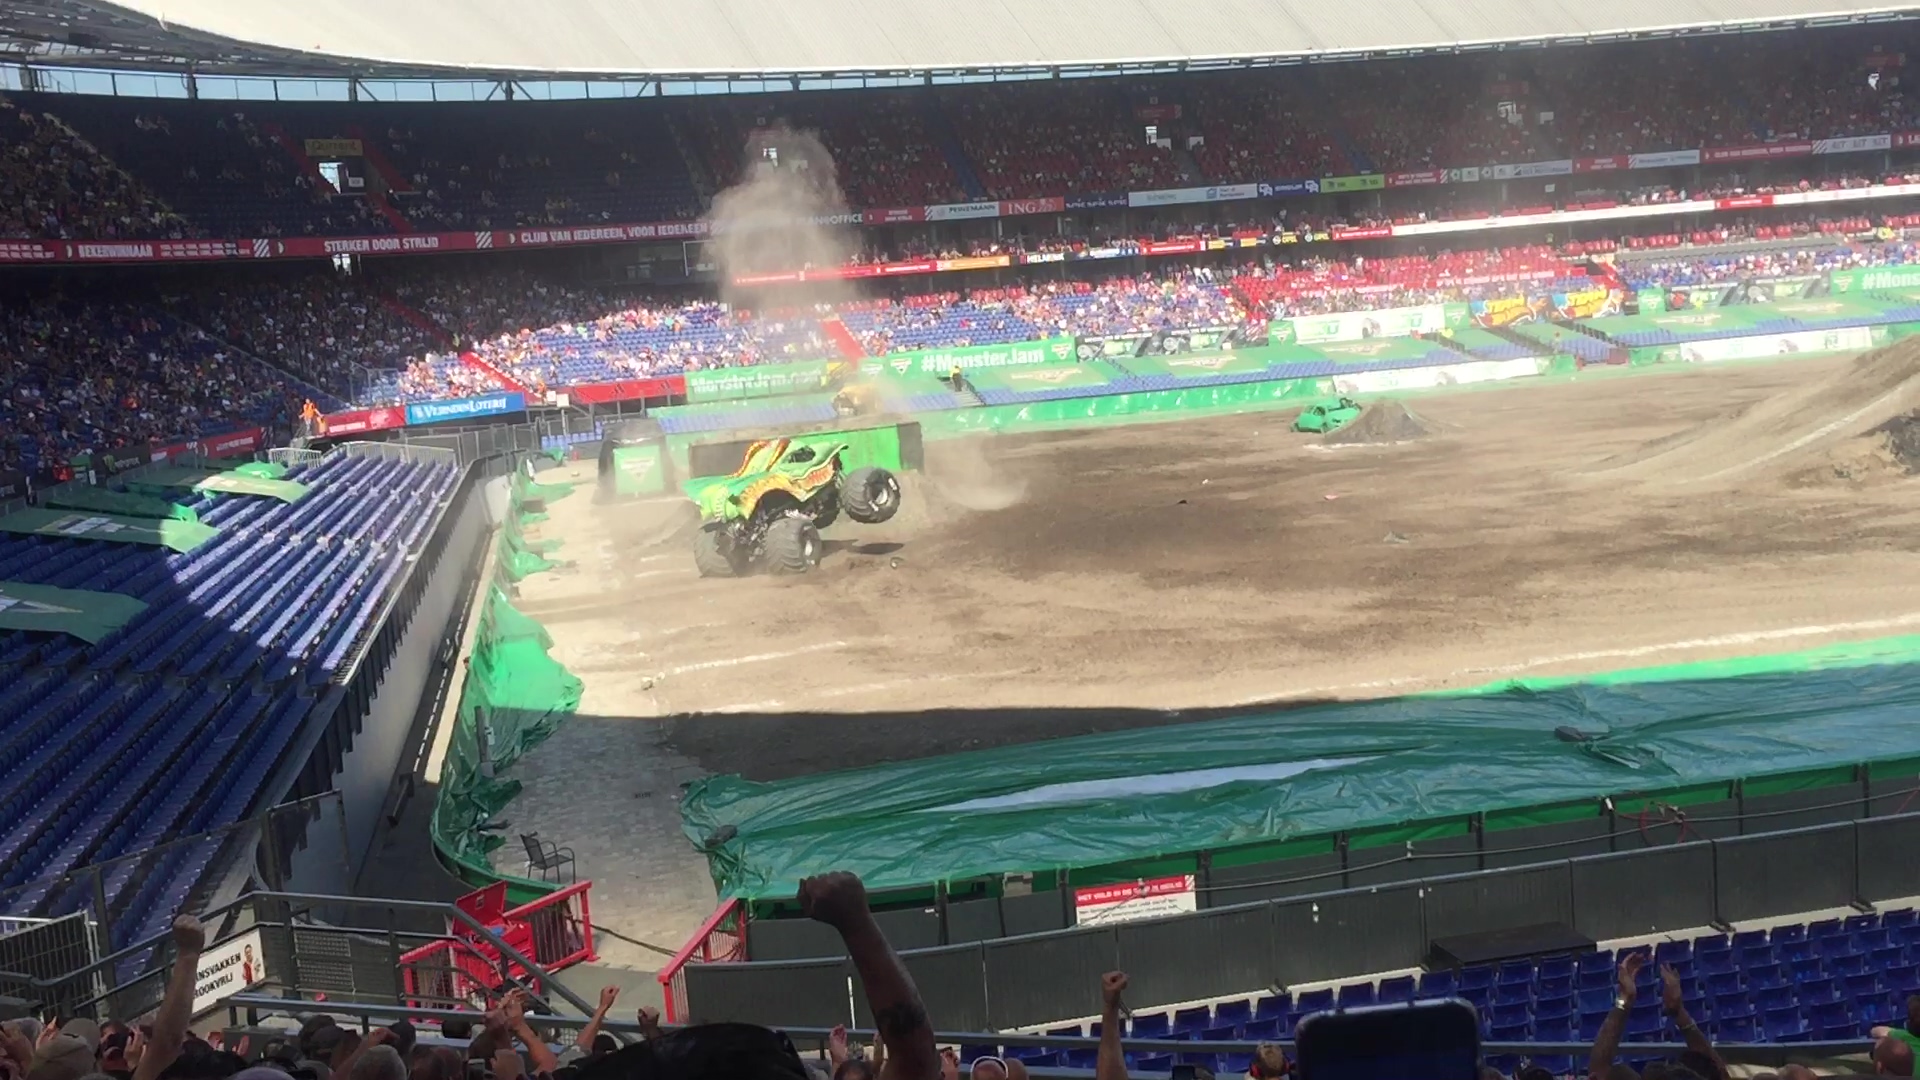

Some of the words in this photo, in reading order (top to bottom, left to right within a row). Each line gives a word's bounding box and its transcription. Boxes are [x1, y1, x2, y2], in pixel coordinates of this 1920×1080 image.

[1008, 203, 1036, 215] ING
[521, 231, 549, 243] CLUB
[550, 230, 572, 242] VAN
[628, 225, 656, 237] VOOR
[372, 239, 401, 250] DOOR
[921, 348, 1045, 372] #MonsterJam
